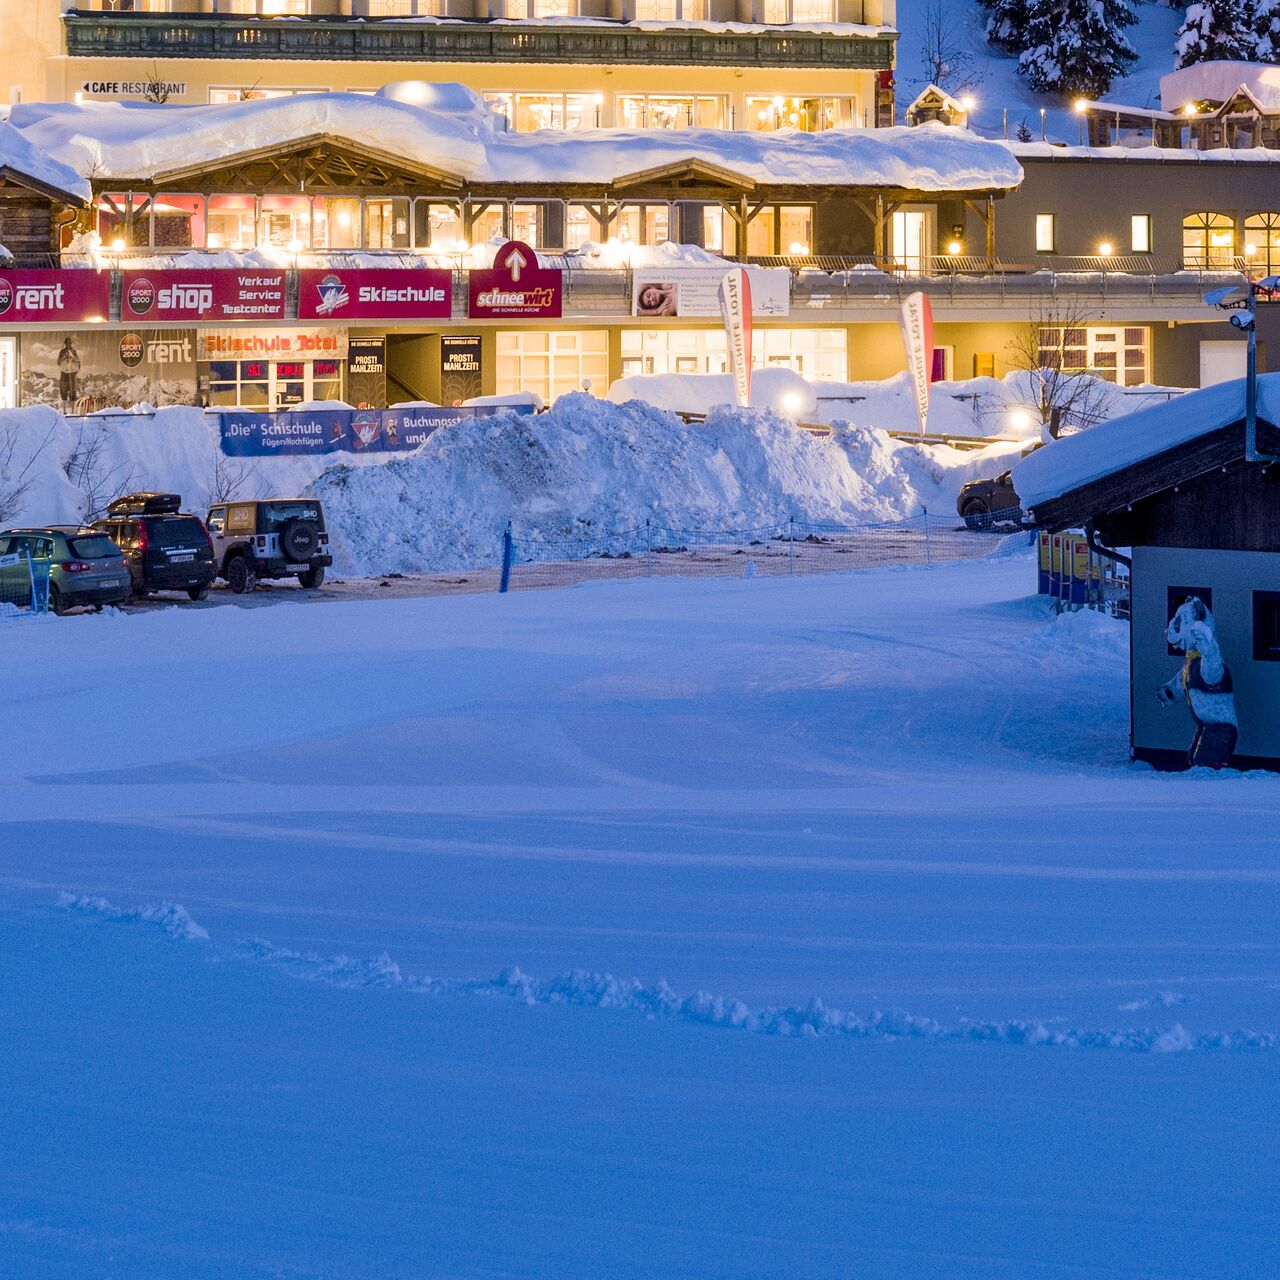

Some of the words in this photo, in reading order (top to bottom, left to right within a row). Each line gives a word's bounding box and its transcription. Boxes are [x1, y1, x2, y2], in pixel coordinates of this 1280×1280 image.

[92, 82, 119, 93] CAFE
[238, 276, 282, 286] Verkauf
[15, 283, 65, 310] rent
[157, 284, 213, 314] shop
[239, 290, 281, 300] Service
[358, 286, 446, 302] Skischule
[476, 287, 553, 307] schneewirt
[131, 296, 151, 304] 2000
[222, 304, 281, 314] Testcenter
[204, 335, 291, 352] Skischule
[297, 334, 337, 351] Total
[147, 337, 192, 363] rent
[355, 355, 378, 364] PROST!
[449, 353, 473, 363] PROST!
[350, 364, 383, 373] MAHLZEIT!
[444, 362, 479, 371] MAHLZEIT!
[260, 422, 323, 436] Schischule
[262, 437, 324, 448] Fügen/Hochfügen
[406, 432, 426, 444] und
